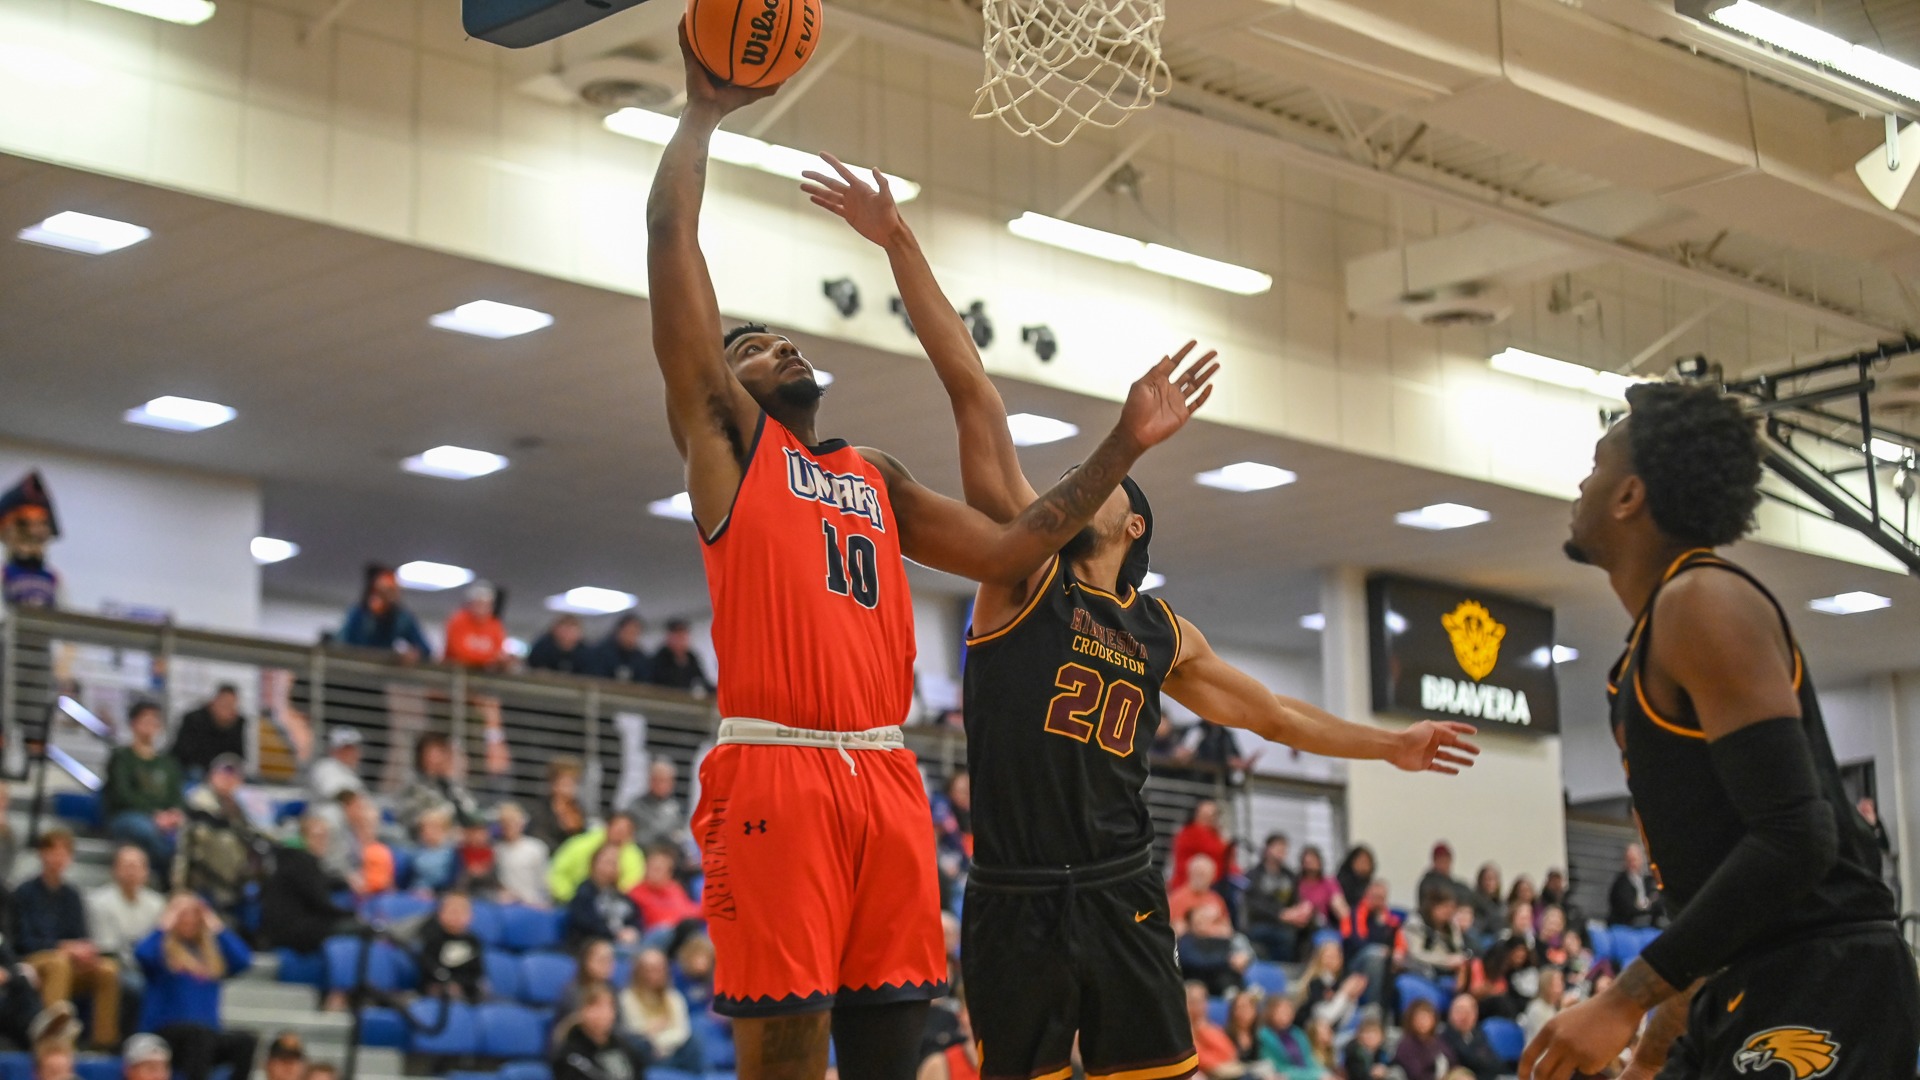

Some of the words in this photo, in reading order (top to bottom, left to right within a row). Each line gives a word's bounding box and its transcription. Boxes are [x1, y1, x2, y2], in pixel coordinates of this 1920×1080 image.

[741, 0, 779, 65] Wilso
[822, 517, 879, 609] 10
[1072, 635, 1145, 676] CROOKSTON
[1044, 661, 1144, 758] 20
[1421, 673, 1531, 726] BRAVERA
